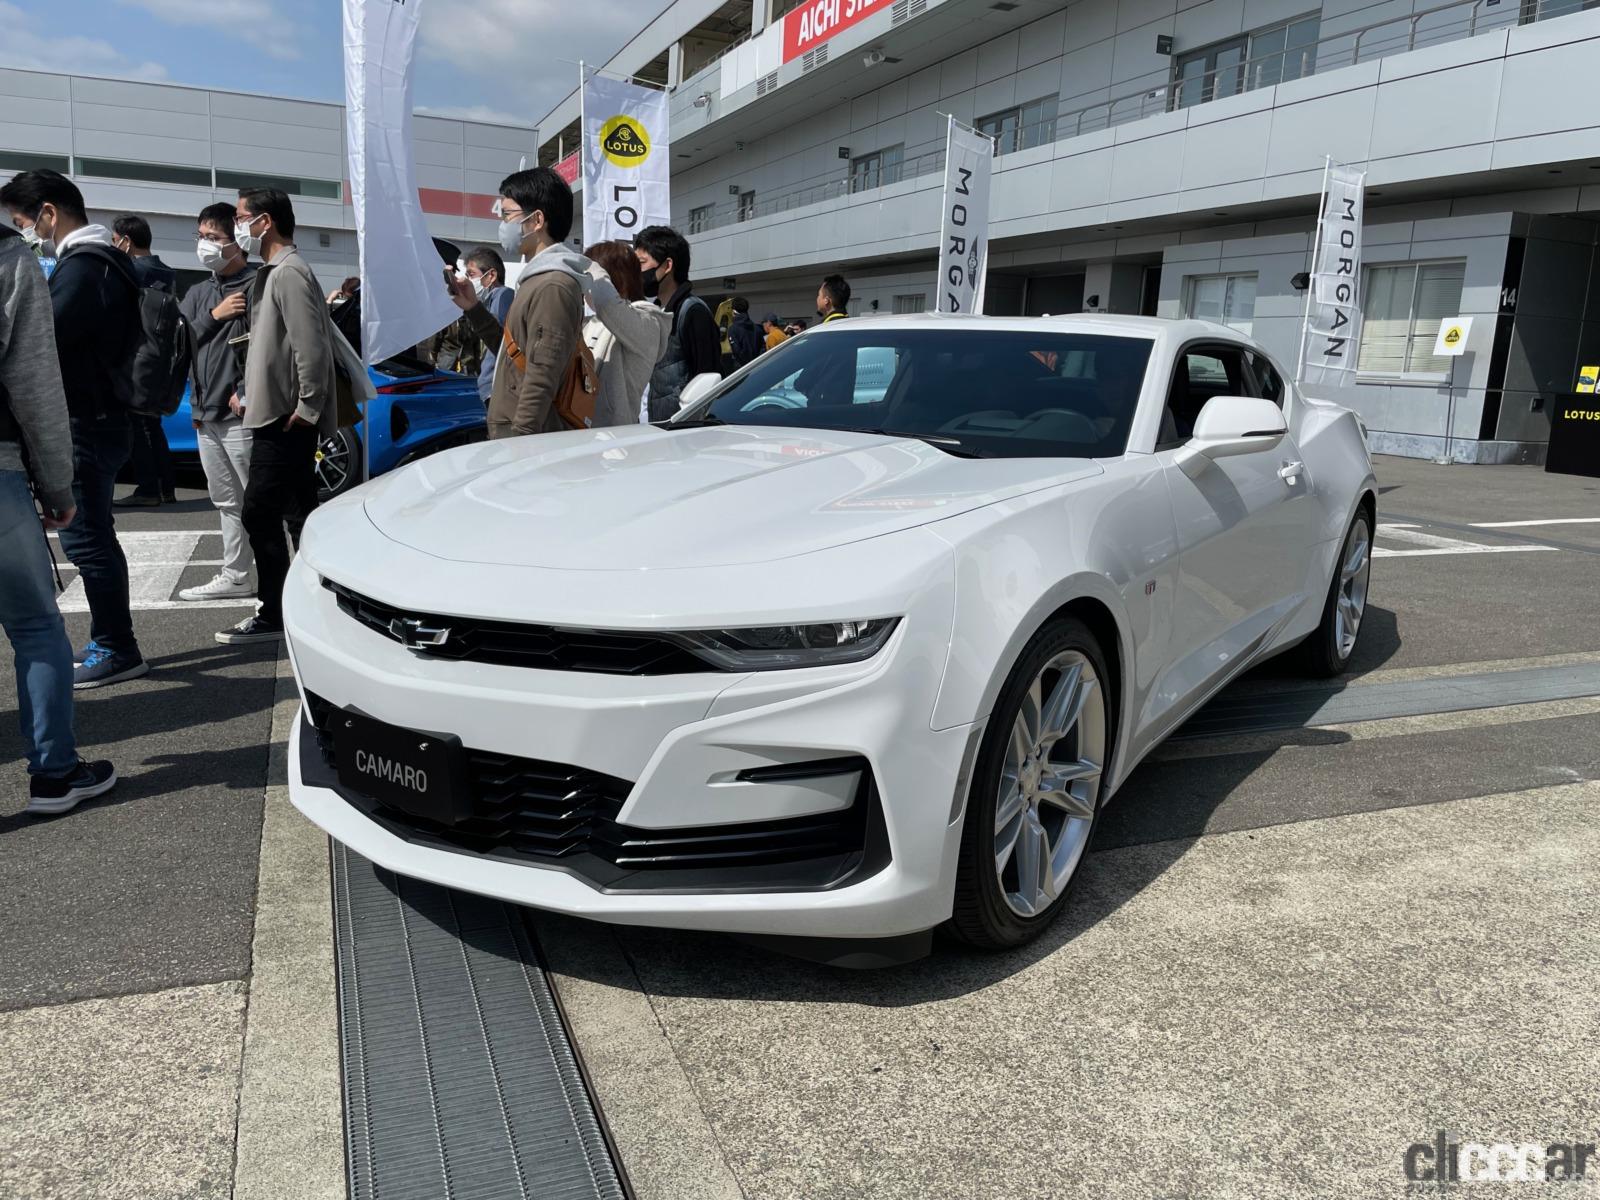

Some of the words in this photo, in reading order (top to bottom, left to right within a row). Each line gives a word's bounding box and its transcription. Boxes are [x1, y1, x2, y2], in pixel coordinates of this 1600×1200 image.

[798, 0, 840, 46] AICHI
[606, 140, 646, 153] LOTUS
[1323, 198, 1355, 357] MORGAN
[1501, 288, 1516, 306] 14
[1564, 409, 1600, 421] LOTUS
[356, 749, 427, 793] CAMARO
